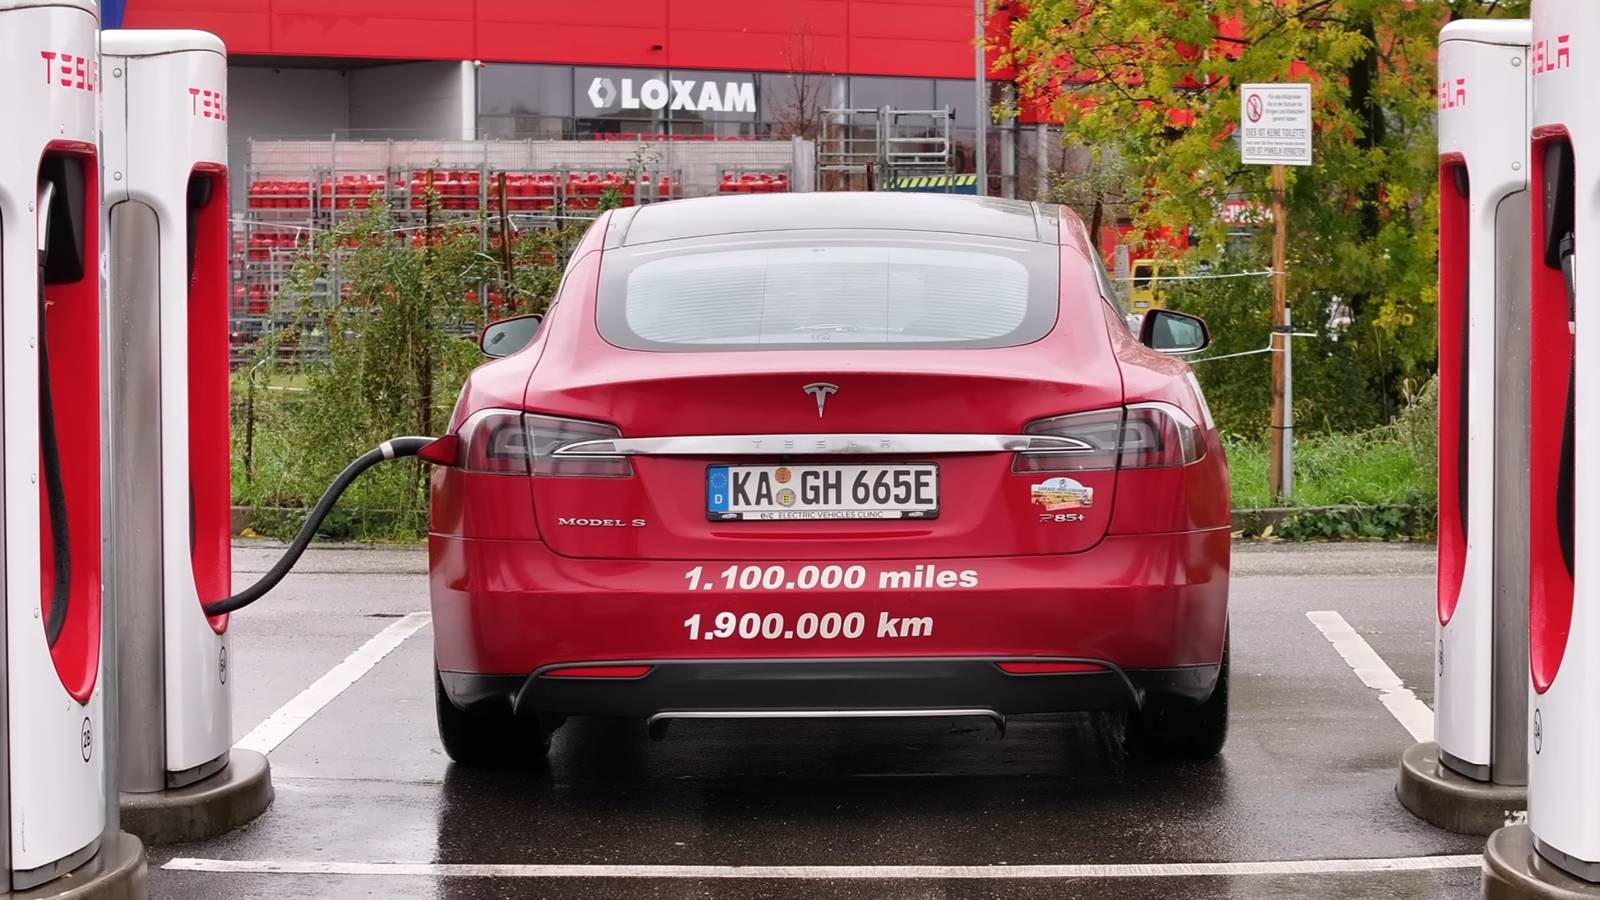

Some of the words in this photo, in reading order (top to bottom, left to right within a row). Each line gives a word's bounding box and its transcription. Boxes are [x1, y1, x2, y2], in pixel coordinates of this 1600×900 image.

[621, 78, 757, 112] LOXAM
[714, 494, 723, 505] D
[732, 471, 773, 505] KA
[801, 470, 842, 504] GH
[852, 470, 934, 505] 665E
[557, 517, 627, 527] MODEL
[631, 518, 646, 527] S
[817, 511, 856, 519] VEHICLES
[685, 565, 866, 590] 1.100.000
[878, 564, 979, 589] miles
[684, 611, 865, 640] 1.900.000
[876, 611, 934, 638] km
